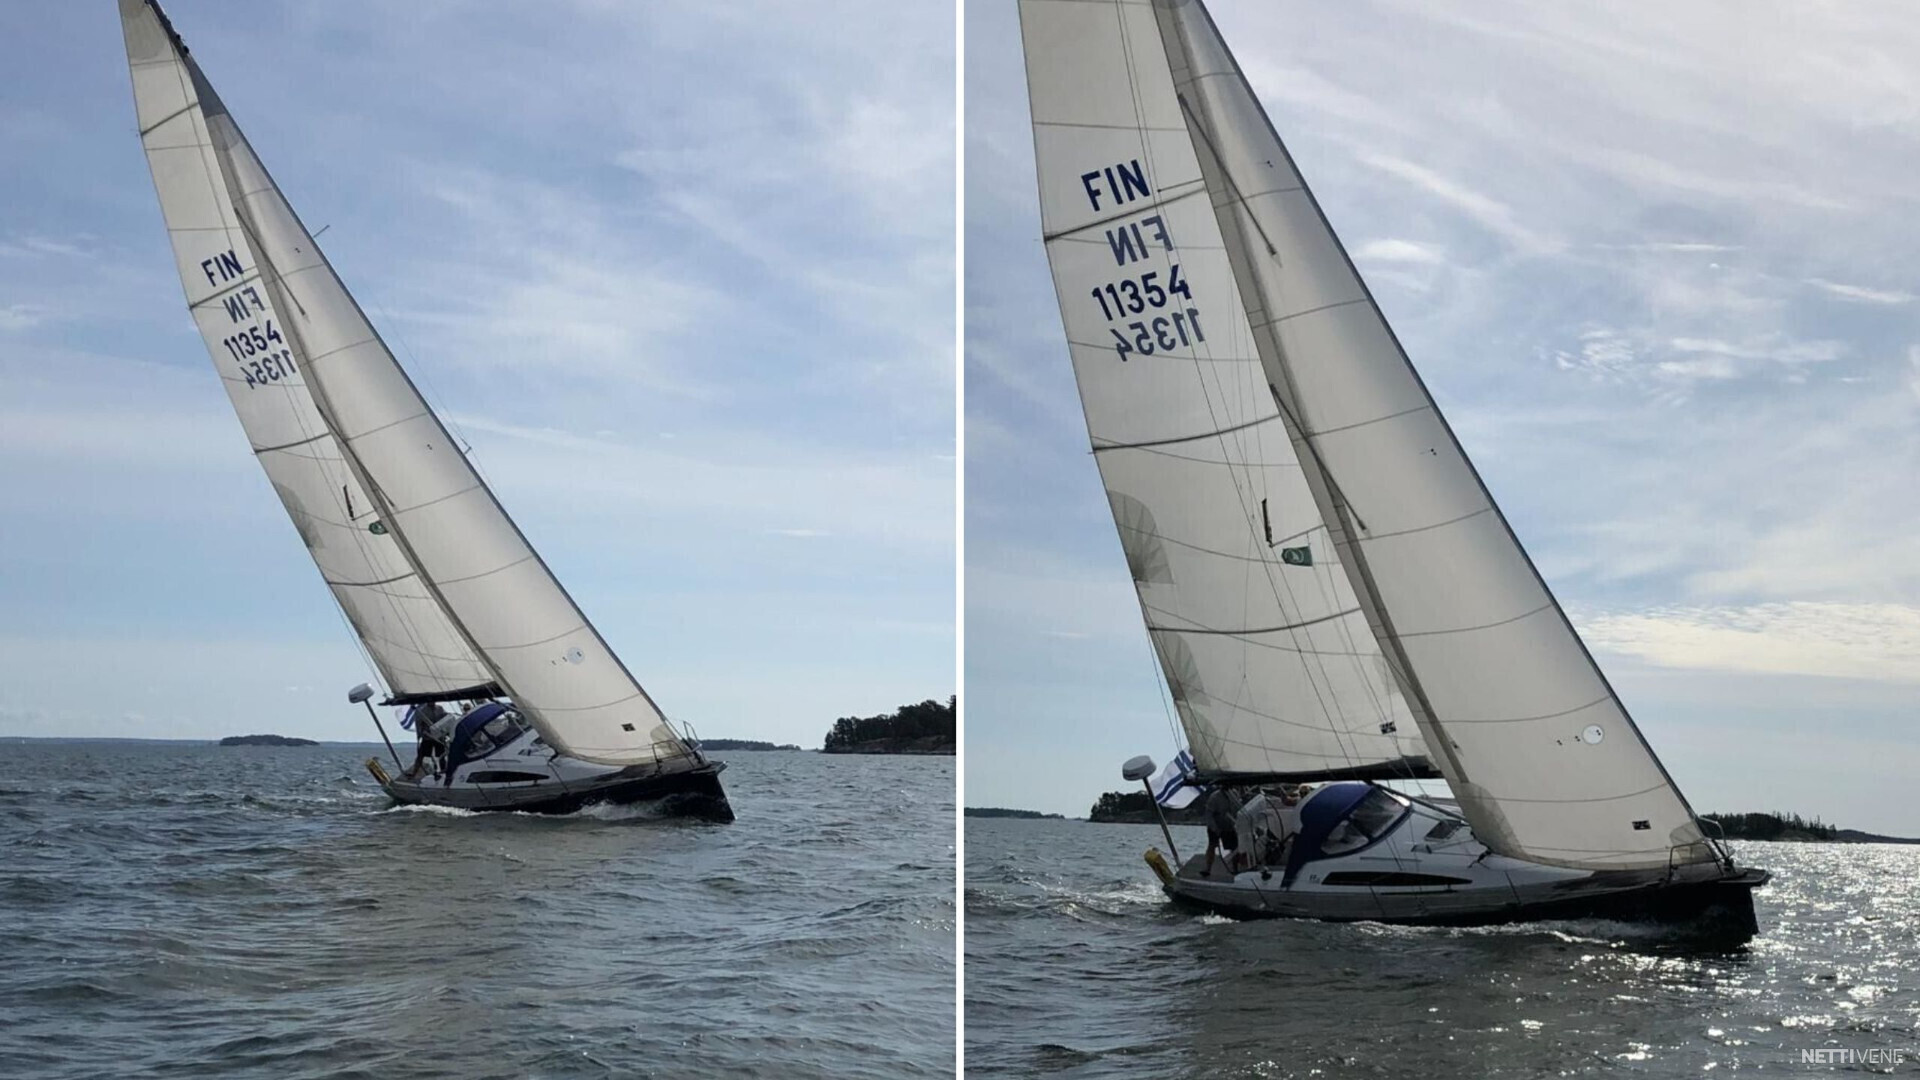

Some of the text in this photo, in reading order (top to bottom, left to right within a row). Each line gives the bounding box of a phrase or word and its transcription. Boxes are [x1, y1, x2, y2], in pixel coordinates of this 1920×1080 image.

[1081, 159, 1150, 212] FIN
[201, 250, 244, 287] FIN
[1092, 264, 1192, 321] 11354
[224, 319, 282, 362] 11354
